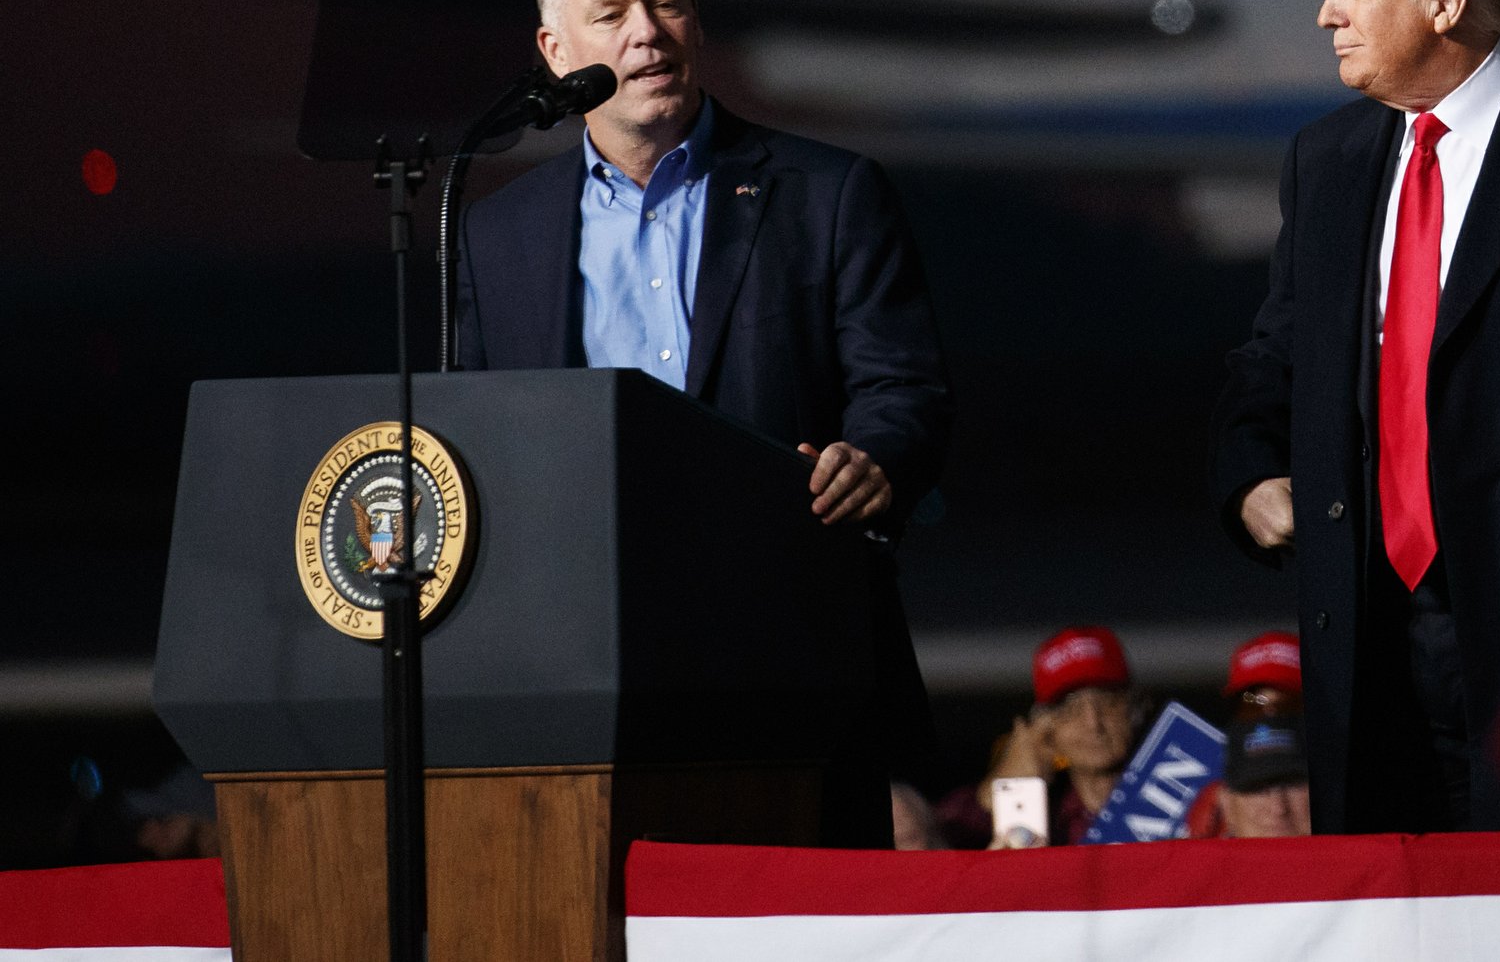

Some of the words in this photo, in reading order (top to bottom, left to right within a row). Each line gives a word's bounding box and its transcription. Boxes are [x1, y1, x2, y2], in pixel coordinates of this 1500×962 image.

[410, 437, 427, 456] HE
[303, 430, 383, 529] PRESIDENT
[429, 452, 462, 540] UNITED
[304, 536, 317, 568] THE
[310, 570, 323, 589] OF
[418, 558, 452, 614] STAT
[322, 595, 364, 630] SEAL
[1124, 741, 1209, 842] AIN
